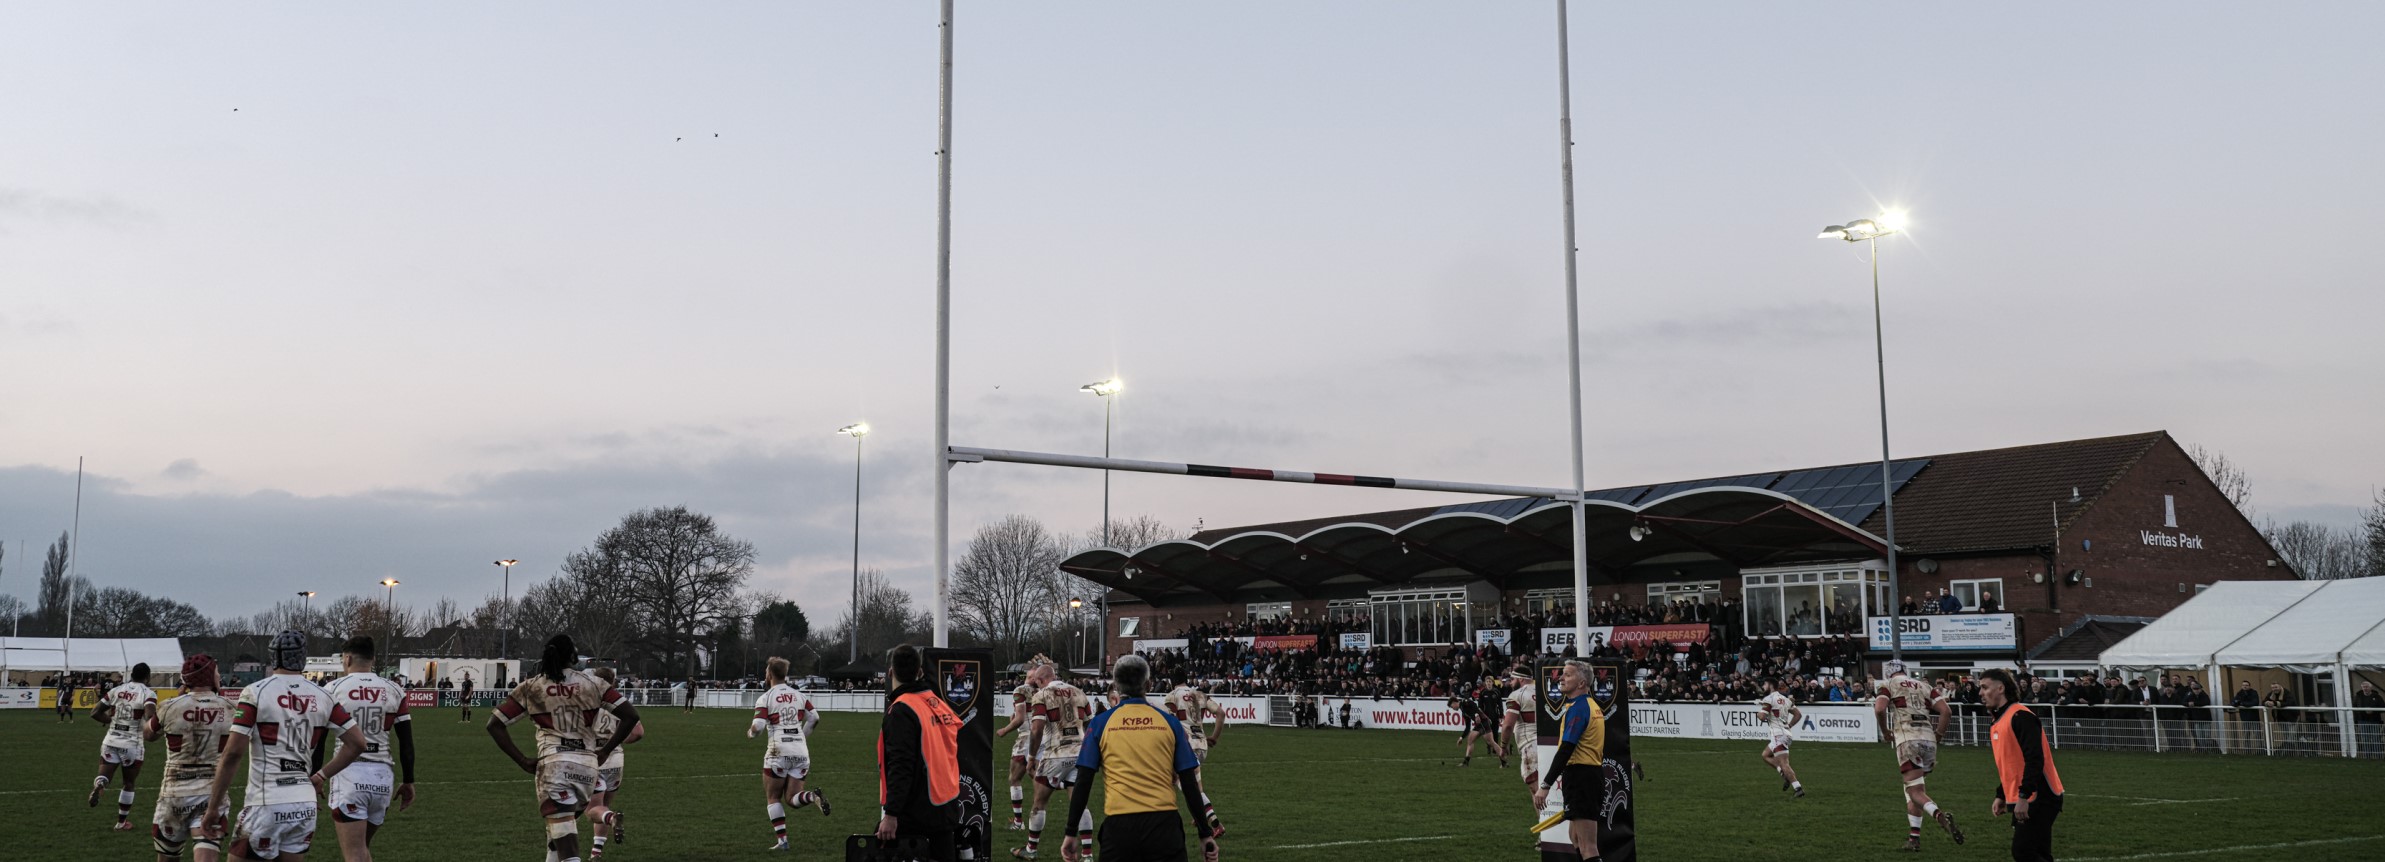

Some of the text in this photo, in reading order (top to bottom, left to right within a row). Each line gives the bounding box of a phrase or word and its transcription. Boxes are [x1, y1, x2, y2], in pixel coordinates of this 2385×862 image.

[2140, 530, 2204, 550] Veritas Park
[1899, 619, 1931, 633] SRD
[1352, 634, 1366, 642] SRD
[1490, 630, 1504, 638] SRD
[1546, 631, 1604, 645] BERYS
[1613, 629, 1706, 642] LONDON SUPERFAST!
[1256, 640, 1277, 649] LONDON
[546, 683, 575, 699] city
[1900, 679, 1918, 690] city
[118, 690, 134, 702] city
[348, 685, 381, 704] city
[410, 692, 434, 701] SIGNS
[445, 691, 511, 699] SUMERFIEL
[776, 693, 793, 704] city
[1054, 687, 1071, 699] city
[277, 690, 310, 715] city
[445, 699, 481, 707] HOES
[183, 706, 219, 725] city
[353, 706, 383, 736] 15
[553, 705, 580, 734] 17
[780, 706, 798, 725] 12
[1122, 717, 1153, 726] KYBO!
[1631, 709, 1680, 725] RITTALL
[1721, 710, 1770, 727] VERITA
[1819, 719, 1861, 728] CORTIZO
[285, 717, 309, 754] 11
[1629, 726, 1680, 735] ECIALIST PARTNER
[1721, 729, 1742, 738] Glazing
[1742, 730, 1769, 738] Solutions
[192, 729, 212, 757] 7
[1602, 757, 1631, 792] ANS RUGBY
[354, 782, 390, 794] THATCHERS
[972, 781, 989, 816] RUGBY
